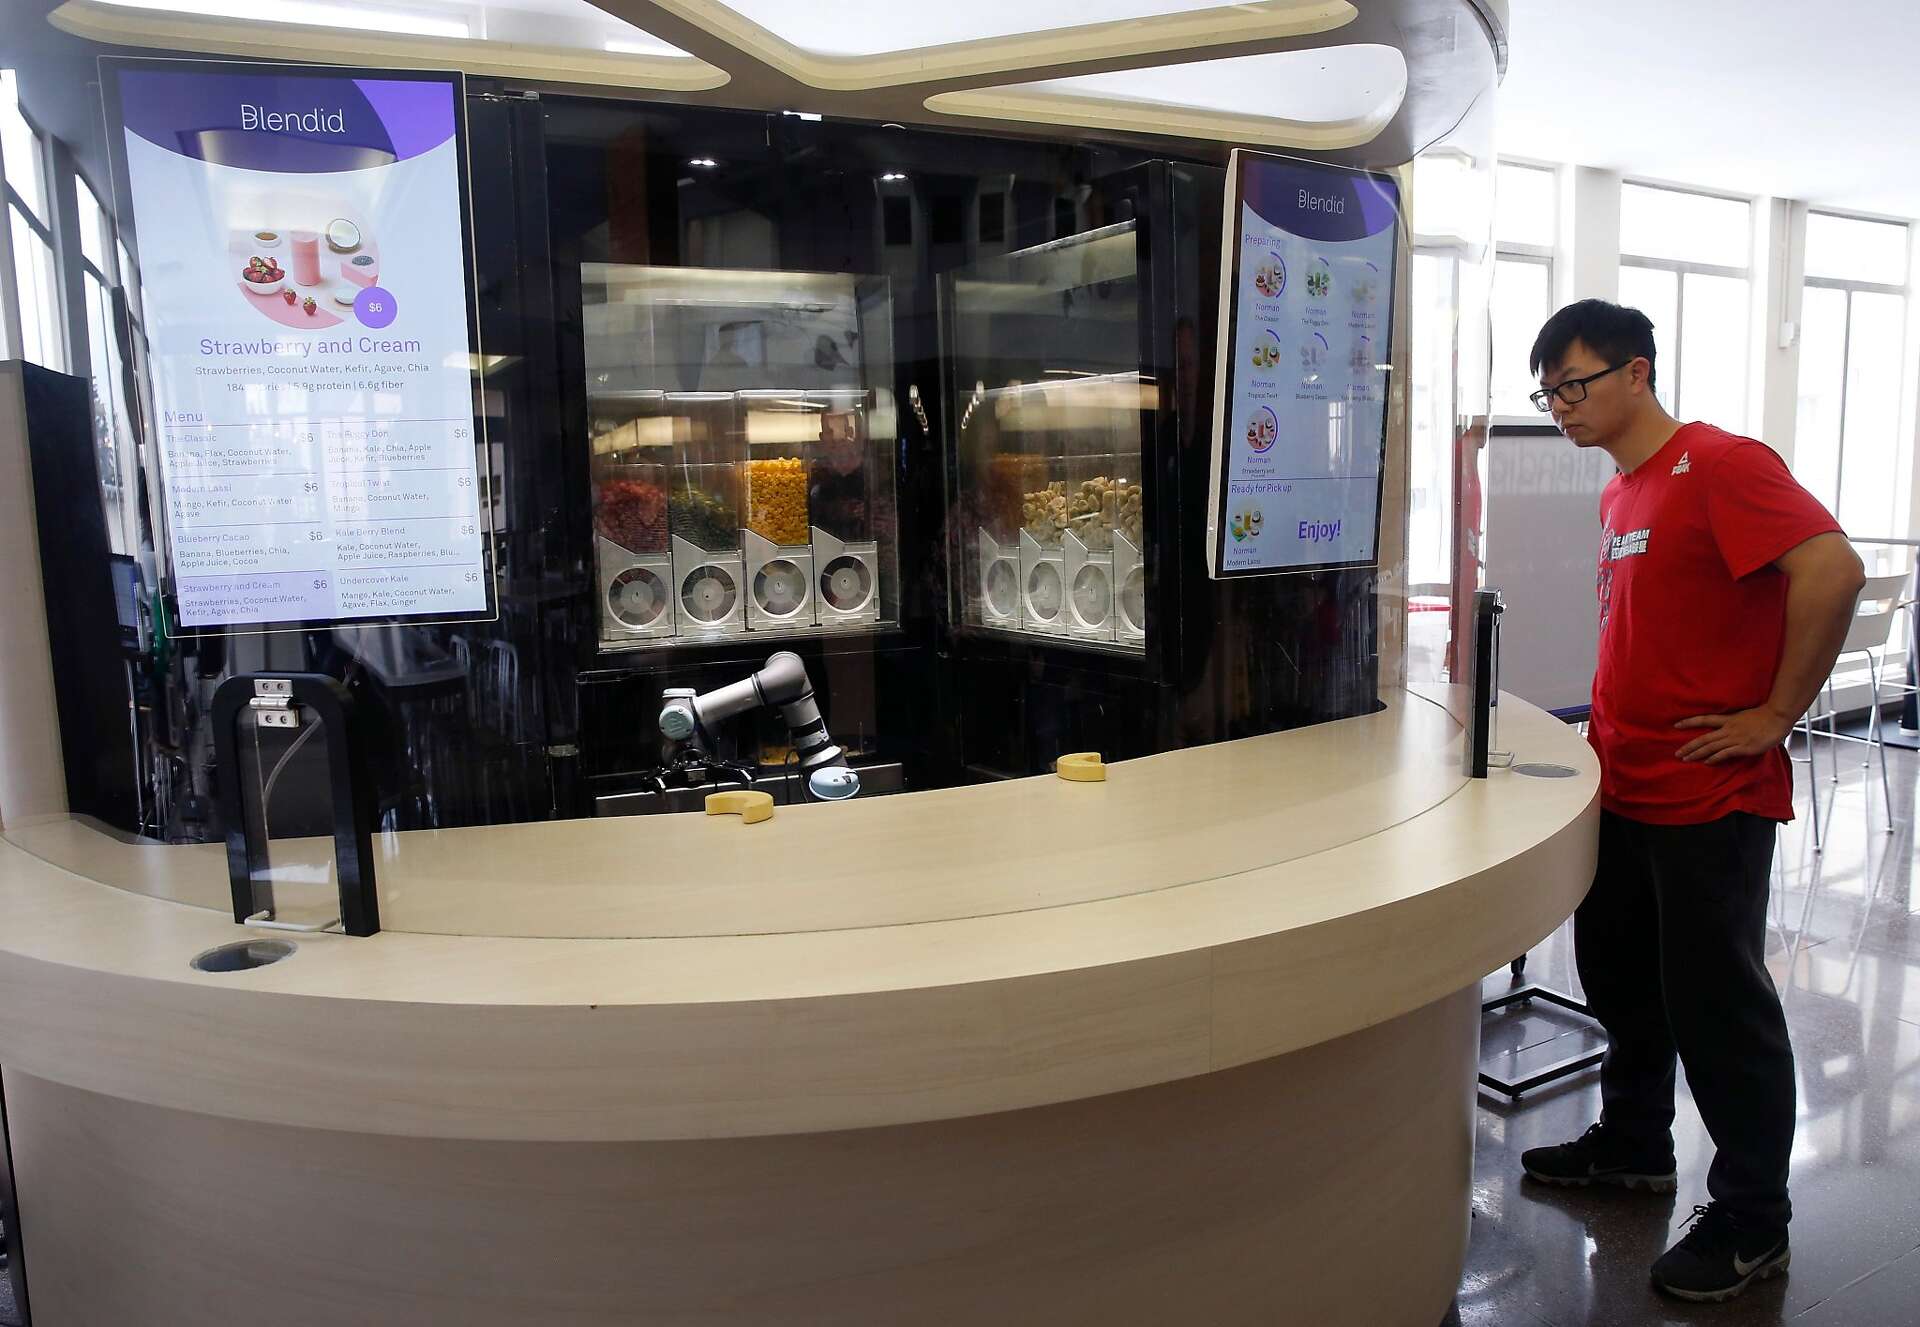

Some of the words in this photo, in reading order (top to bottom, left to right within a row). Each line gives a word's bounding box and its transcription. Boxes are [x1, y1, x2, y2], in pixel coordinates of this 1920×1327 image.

[242, 104, 345, 133] Blendid
[1298, 189, 1344, 214] Blendid
[1245, 234, 1280, 249] Preparing
[369, 301, 382, 314] $6
[200, 339, 311, 357] Strawberry
[318, 338, 352, 353] and
[359, 337, 420, 353] Cream
[196, 367, 265, 375] Strawberries,
[267, 366, 307, 374] Coconut
[311, 365, 342, 374] Water,
[345, 364, 371, 374] Kefir,
[375, 364, 405, 374] Agave,
[408, 364, 429, 372] Chia
[317, 381, 351, 390] protein
[359, 381, 379, 391] 6.6g
[382, 381, 404, 389] fiber
[164, 411, 203, 422] Menu
[372, 430, 388, 438] Don
[454, 429, 468, 438] $6
[409, 444, 431, 452] Apple
[457, 477, 471, 487] $6
[304, 483, 318, 492] $6
[1231, 485, 1254, 495] Ready
[1255, 484, 1266, 492] for
[1267, 484, 1282, 492] Pick
[1283, 485, 1292, 494] up
[403, 493, 429, 501] Water,
[174, 501, 204, 509] Mngo,
[461, 525, 474, 535] $6
[1299, 520, 1340, 542] Enjoy!
[178, 535, 220, 543] Blueberry
[223, 534, 250, 542] Cacao
[309, 531, 323, 541] $6
[269, 547, 289, 555] Chia,
[338, 553, 360, 561] Apple
[388, 551, 439, 559] Raspberries,
[181, 560, 202, 568] Apple
[206, 559, 231, 567] Juice,
[391, 575, 408, 583] Kale
[465, 573, 478, 582] $6
[184, 584, 232, 593] Strawberry
[314, 579, 327, 589] $6
[341, 591, 370, 600] Mango,
[395, 589, 427, 597] Coconut
[429, 588, 455, 596] Water,
[185, 599, 242, 607] Strawberries,
[244, 596, 277, 604] Coconut
[279, 595, 306, 603] Water,
[342, 601, 369, 609] Agave,
[392, 599, 417, 607] Ginger
[211, 608, 238, 616] Agave,
